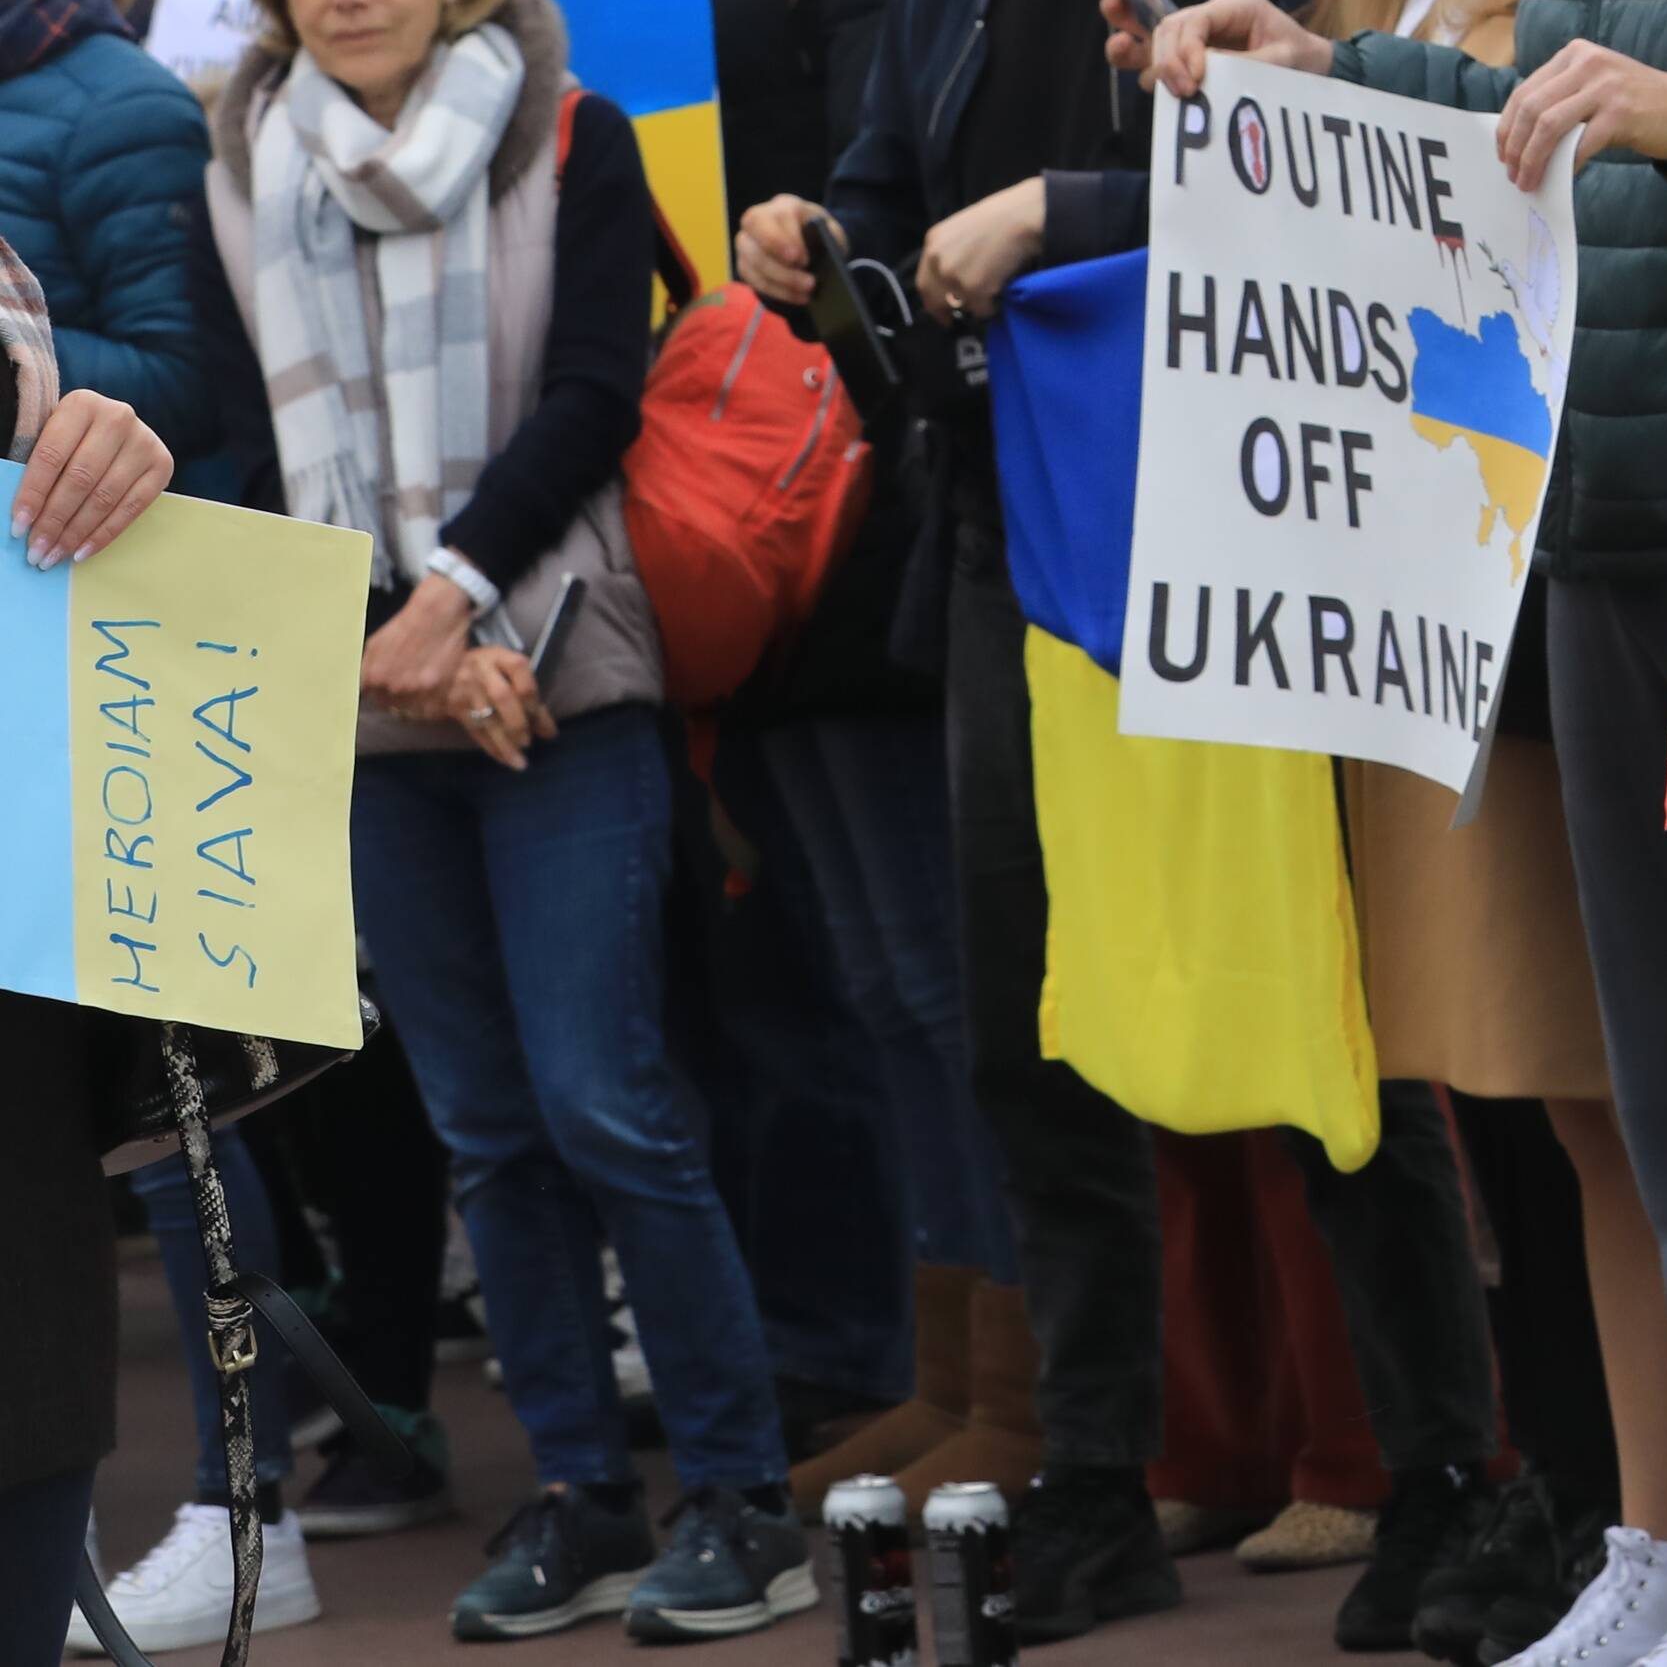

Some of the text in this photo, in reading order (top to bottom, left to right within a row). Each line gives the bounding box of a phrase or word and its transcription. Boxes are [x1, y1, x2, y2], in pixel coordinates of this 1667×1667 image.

[1173, 89, 1465, 240] POUTINE
[1165, 270, 1409, 405] HANDS
[1239, 416, 1375, 529] OFF
[1147, 581, 1494, 744] UKRAINE
[91, 619, 161, 994] HEROIAM
